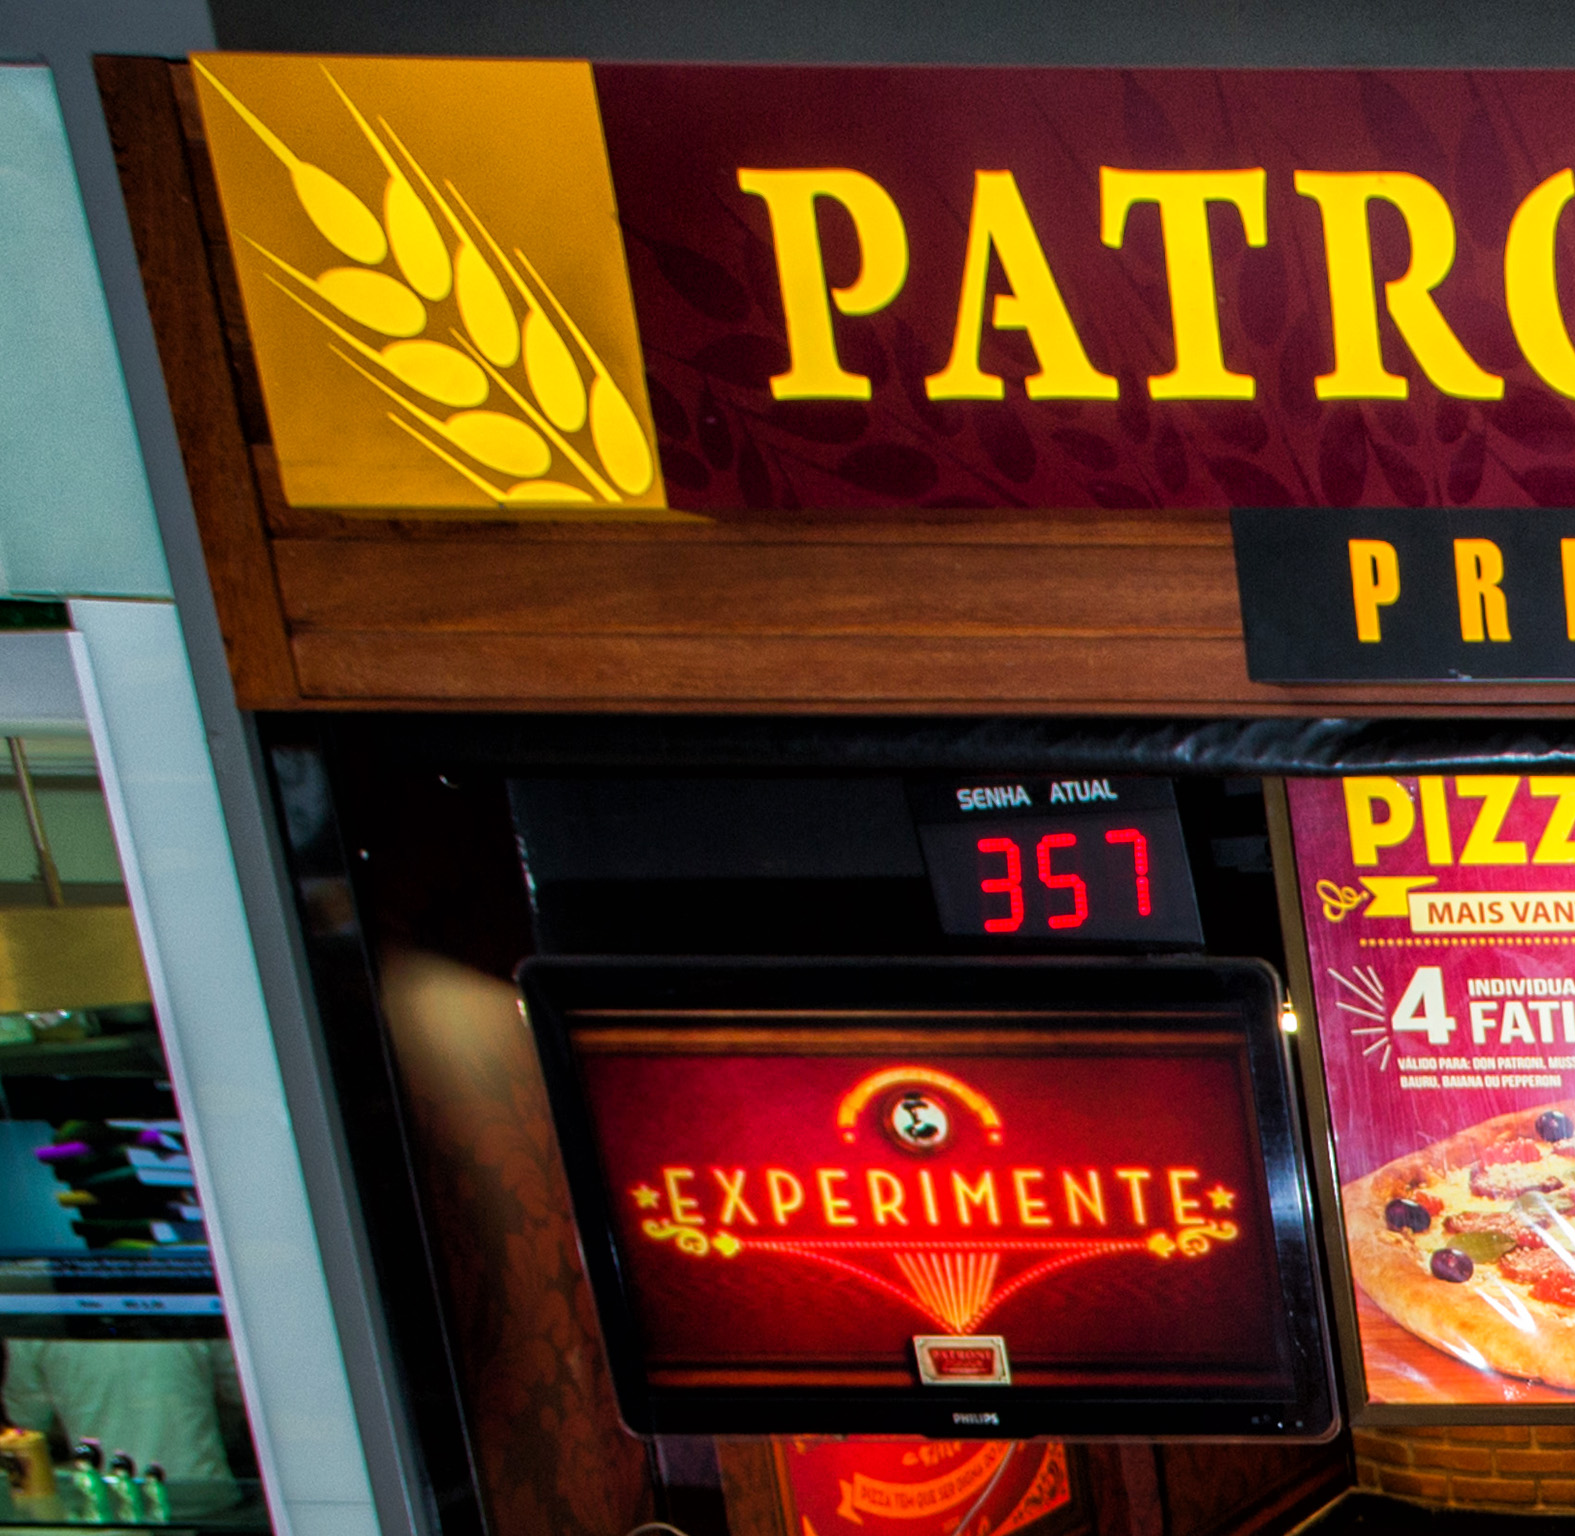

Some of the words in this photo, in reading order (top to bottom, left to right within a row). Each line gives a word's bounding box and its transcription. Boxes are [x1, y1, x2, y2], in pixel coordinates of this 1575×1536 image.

[957, 785, 1032, 811] SENHA
[1049, 778, 1118, 804] ATUAL
[976, 828, 1152, 933] 357
[1427, 901, 1504, 925] MAIS
[1391, 965, 1456, 1045] 4
[1398, 1055, 1437, 1071] VÁLIDO
[1438, 1056, 1471, 1071] PARA:
[1442, 1074, 1483, 1088] BAIANA
[1501, 1074, 1562, 1088] PEPPERONI
[663, 1166, 1207, 1228] EXPERIMENTE
[952, 1411, 1000, 1427] PHILIPS
